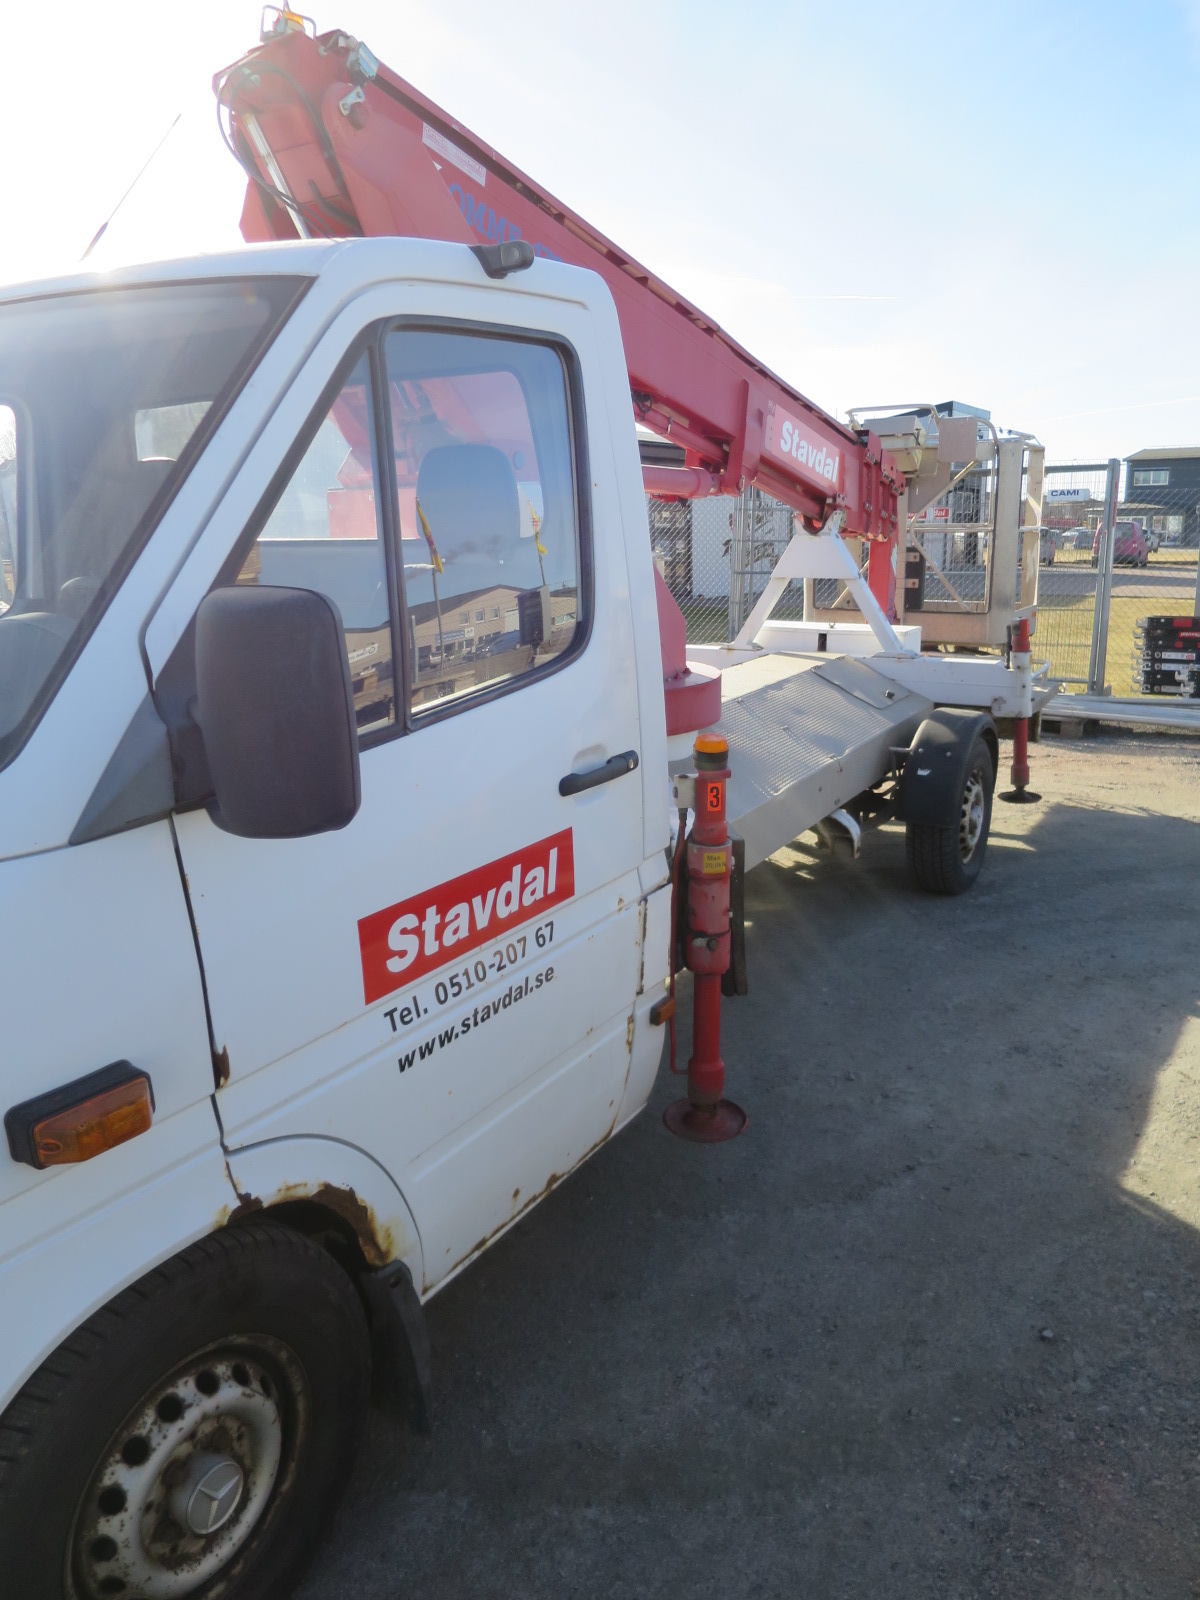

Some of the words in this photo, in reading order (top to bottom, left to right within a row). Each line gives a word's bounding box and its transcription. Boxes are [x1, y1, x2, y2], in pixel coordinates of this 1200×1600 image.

[780, 421, 840, 482] Stavdal
[1050, 489, 1080, 497] CAMI
[709, 786, 719, 808] 3
[386, 846, 559, 973] Stavdal
[383, 995, 428, 1033] Tel.
[434, 935, 528, 1006] 0510-207
[534, 920, 555, 948] 67
[397, 965, 555, 1074] www.stavdal.se
